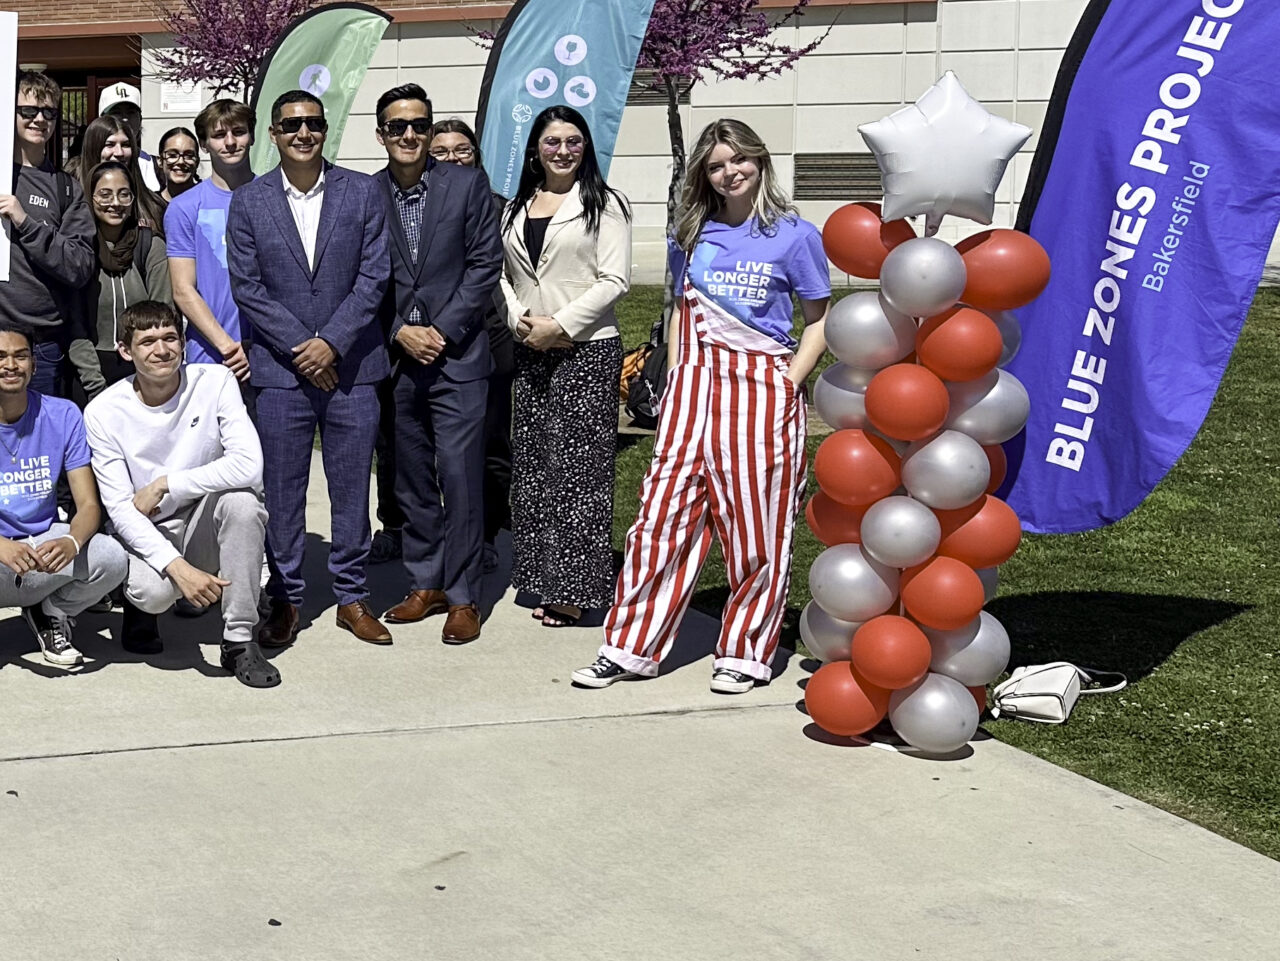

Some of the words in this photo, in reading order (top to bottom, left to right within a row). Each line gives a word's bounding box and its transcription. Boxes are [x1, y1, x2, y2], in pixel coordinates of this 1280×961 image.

[512, 125, 522, 145] BLUE
[507, 146, 518, 172] ZONES
[502, 173, 512, 196] PROJE
[29, 194, 49, 208] EDEN
[1141, 160, 1211, 293] Bakersfield
[735, 260, 773, 275] LIVE
[703, 270, 770, 287] LONGER
[707, 283, 767, 299] BETTER
[1045, 348, 1107, 472] BLUE
[1082, 180, 1158, 346] ZONES
[20, 455, 50, 469] LIVE
[0, 479, 52, 497] BETTER
